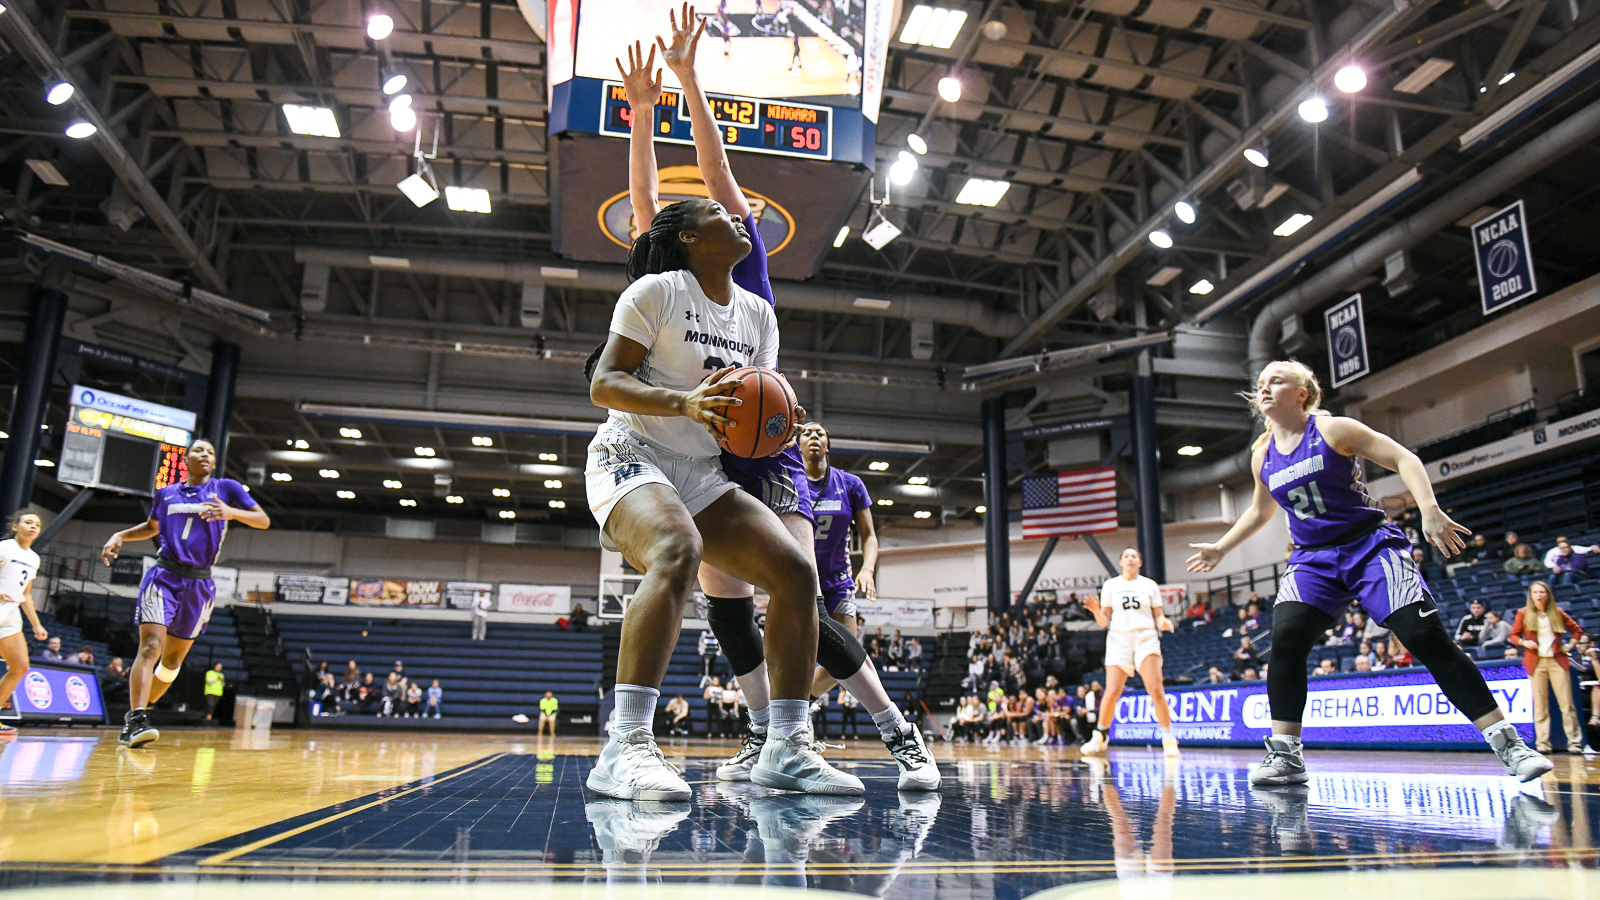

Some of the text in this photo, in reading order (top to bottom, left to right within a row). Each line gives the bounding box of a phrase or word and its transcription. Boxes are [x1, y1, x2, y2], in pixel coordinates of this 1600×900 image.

[767, 104, 817, 123] NIAGARA
[726, 126, 738, 144] 3
[791, 126, 821, 150] 50
[1480, 213, 1519, 246] NCAA
[1492, 274, 1522, 301] 2001
[1330, 304, 1357, 330] NCAA
[684, 329, 755, 358] MONMOUTH
[1268, 454, 1325, 492] NIAGARA
[1287, 480, 1327, 521] 21
[181, 517, 194, 540] 1
[19, 569, 29, 587] 3
[406, 581, 440, 594] NOW
[1122, 596, 1141, 610] 25
[1114, 689, 1238, 724] CURRENT
[1310, 695, 1384, 719] REHAB.
[1114, 726, 1154, 740] RECOVERY
